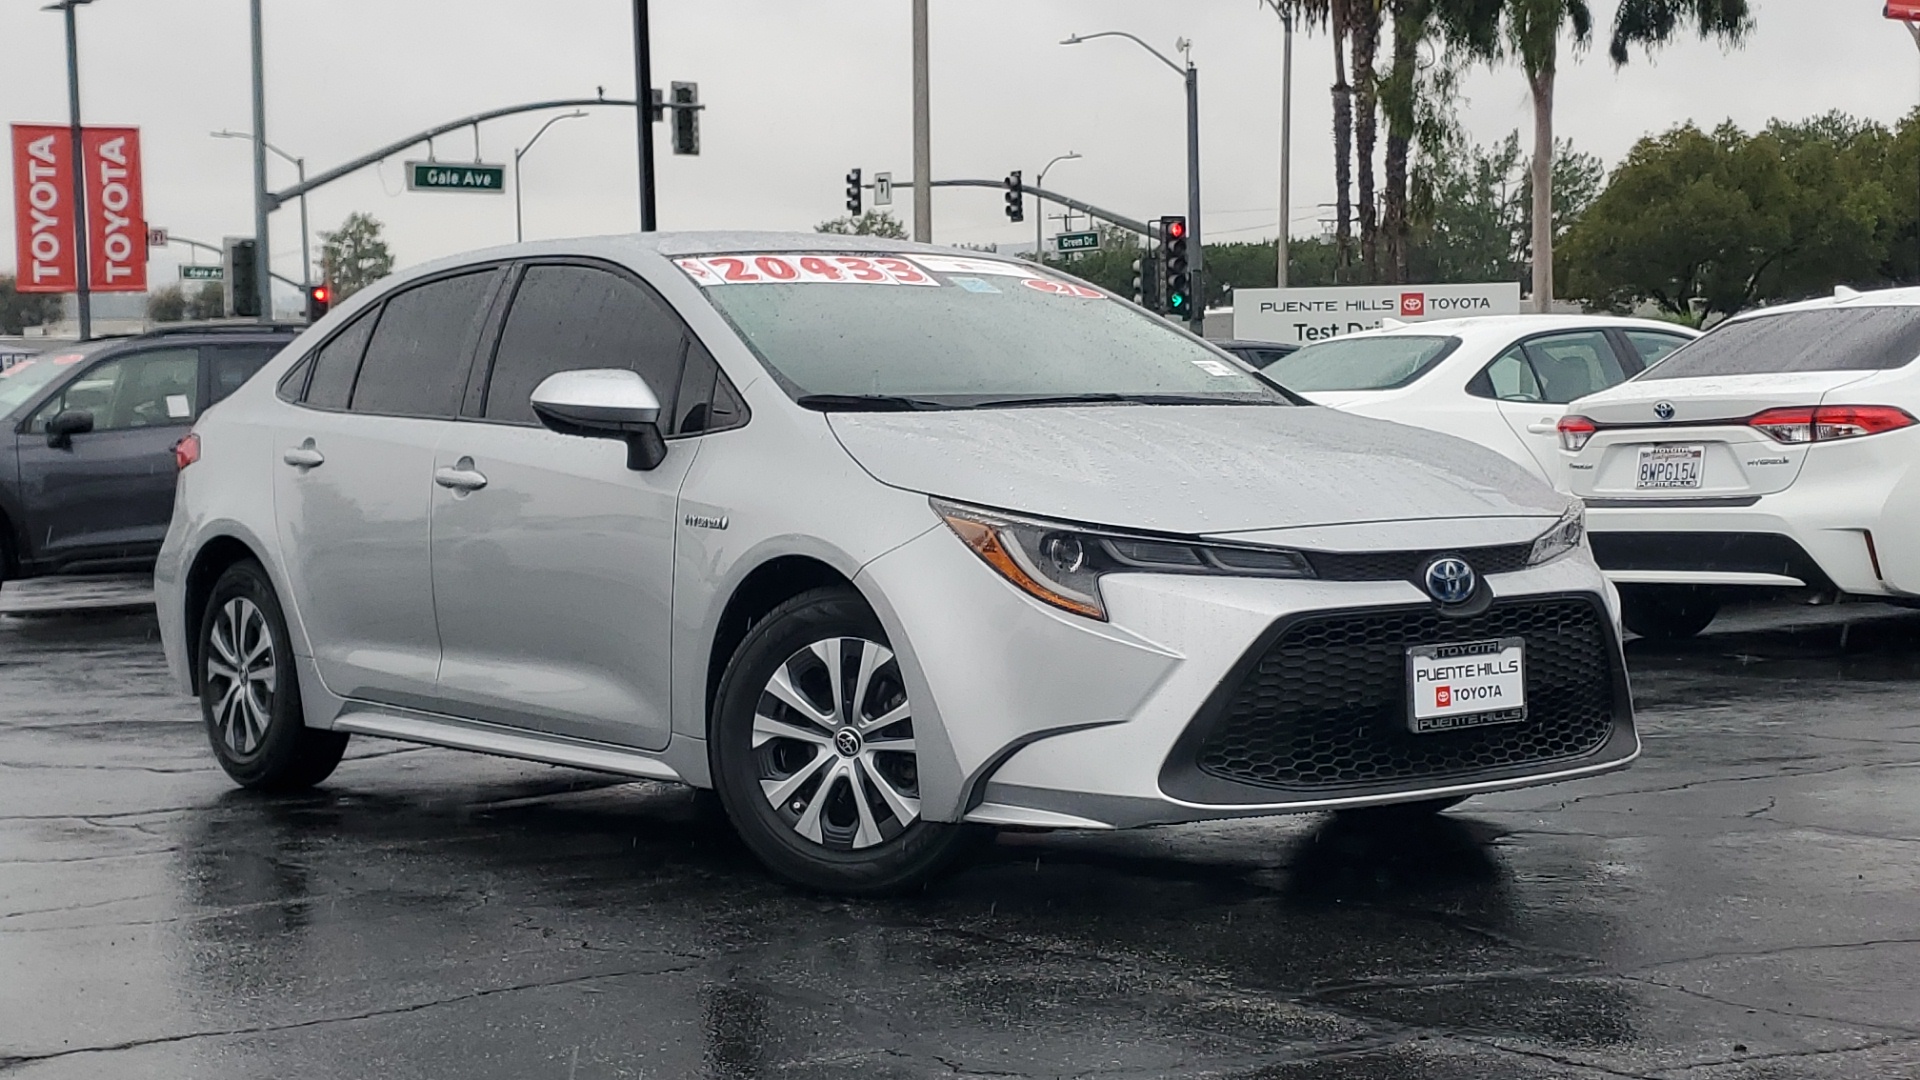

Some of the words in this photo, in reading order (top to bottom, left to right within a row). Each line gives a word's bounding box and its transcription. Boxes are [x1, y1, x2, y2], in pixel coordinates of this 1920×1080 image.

[427, 169, 460, 185] Gale
[463, 171, 492, 187] Ave
[28, 134, 60, 284] TOYOTA
[99, 136, 132, 284] TOYOTA
[1062, 238, 1083, 247] Green
[1083, 235, 1093, 246] Dr
[1260, 301, 1338, 313] PUENTE
[1346, 299, 1394, 312] HILLS
[1429, 297, 1491, 310] TOYOTA
[1293, 323, 1340, 341] Test
[1640, 462, 1697, 481] 8WPG154
[1438, 643, 1498, 657] TOYOTA
[1416, 665, 1475, 682] PUENTE
[1477, 660, 1519, 677] HILLS
[1453, 685, 1503, 701] TOYOTA
[1420, 715, 1479, 730] PUENTE
[1480, 709, 1521, 723] HILLS
